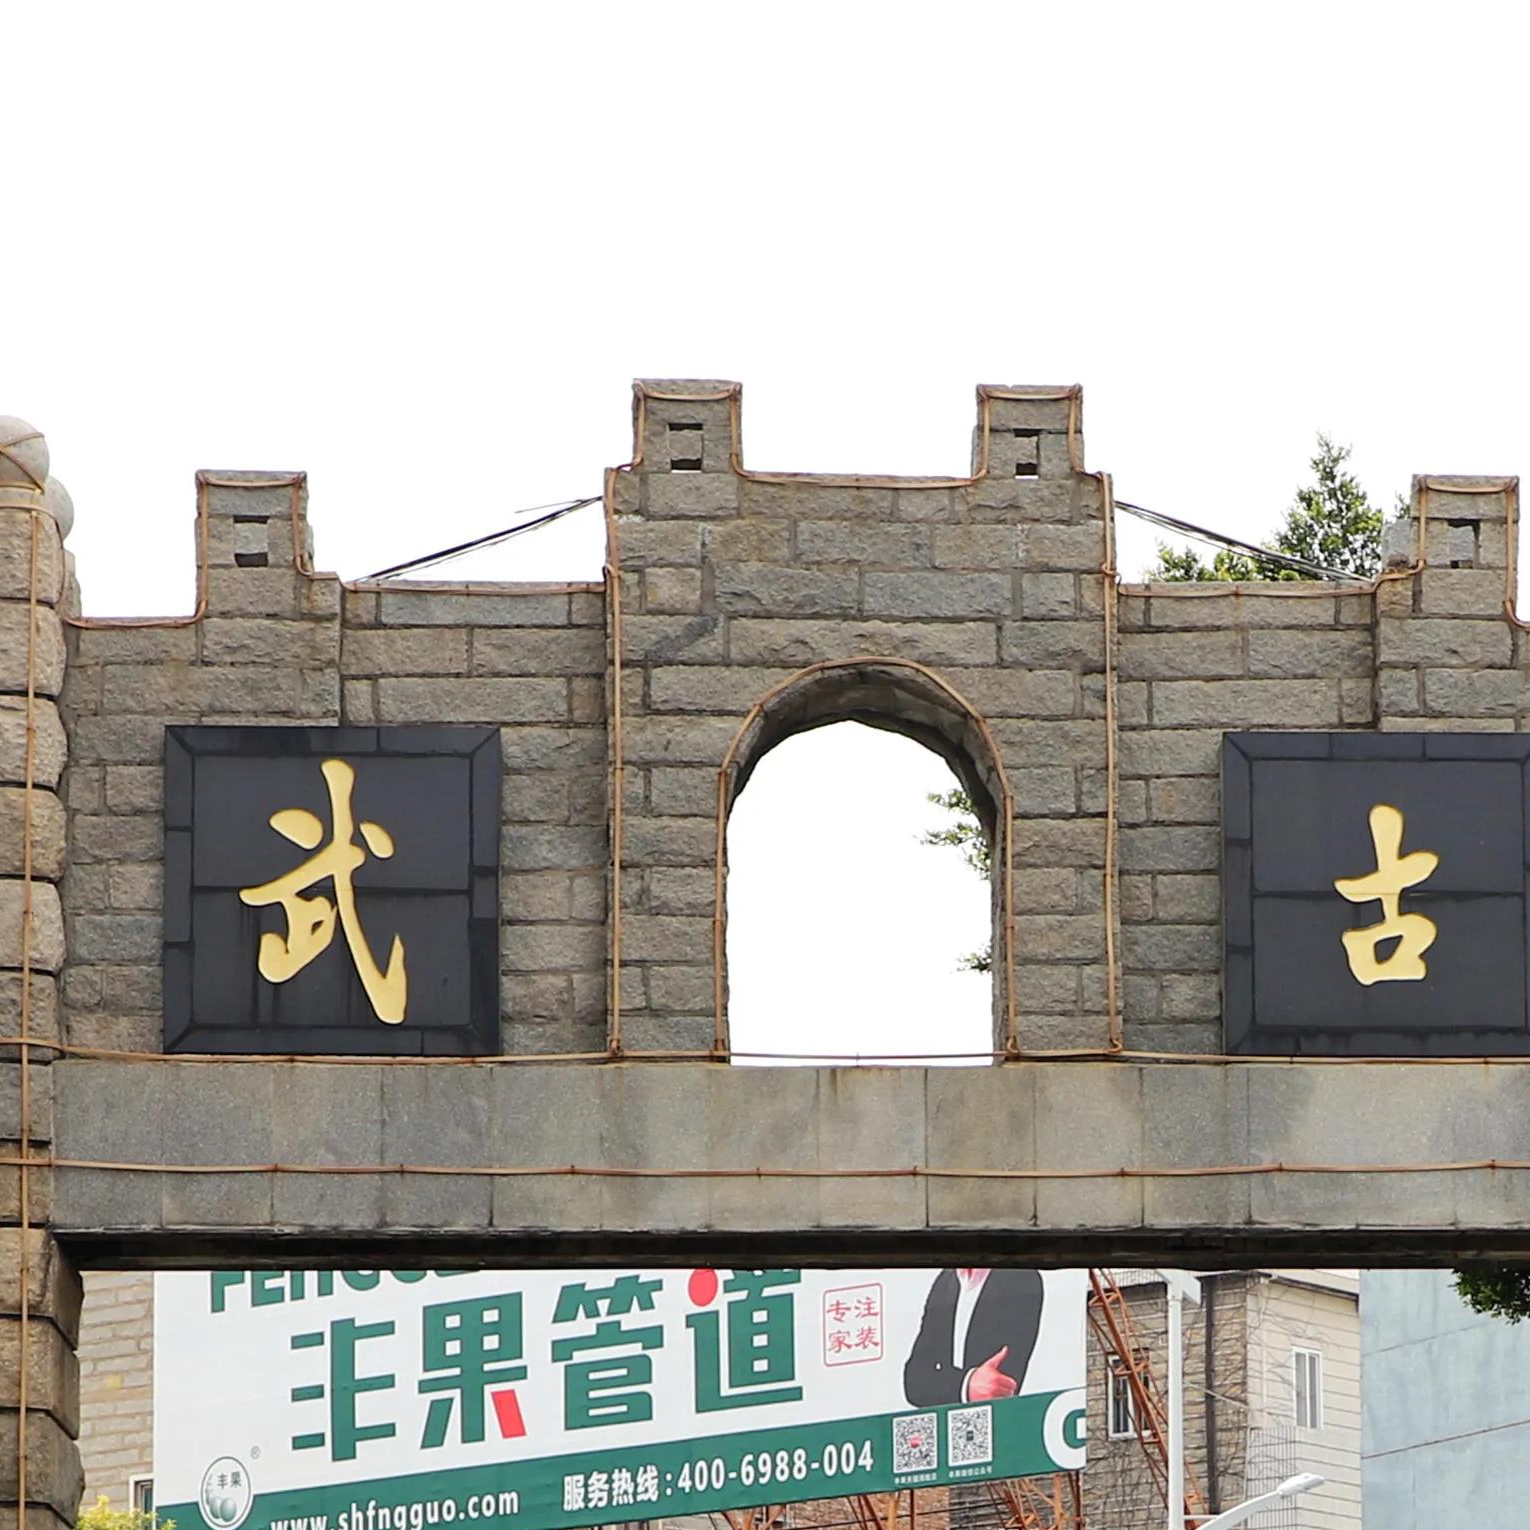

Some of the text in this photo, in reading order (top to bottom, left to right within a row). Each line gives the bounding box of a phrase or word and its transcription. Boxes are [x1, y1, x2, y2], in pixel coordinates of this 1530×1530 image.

[238, 758, 410, 1026] 武
[1333, 803, 1441, 987] 古
[826, 1296, 881, 1323] 专注
[827, 1325, 881, 1354] 家装
[217, 1470, 243, 1490] 丰果
